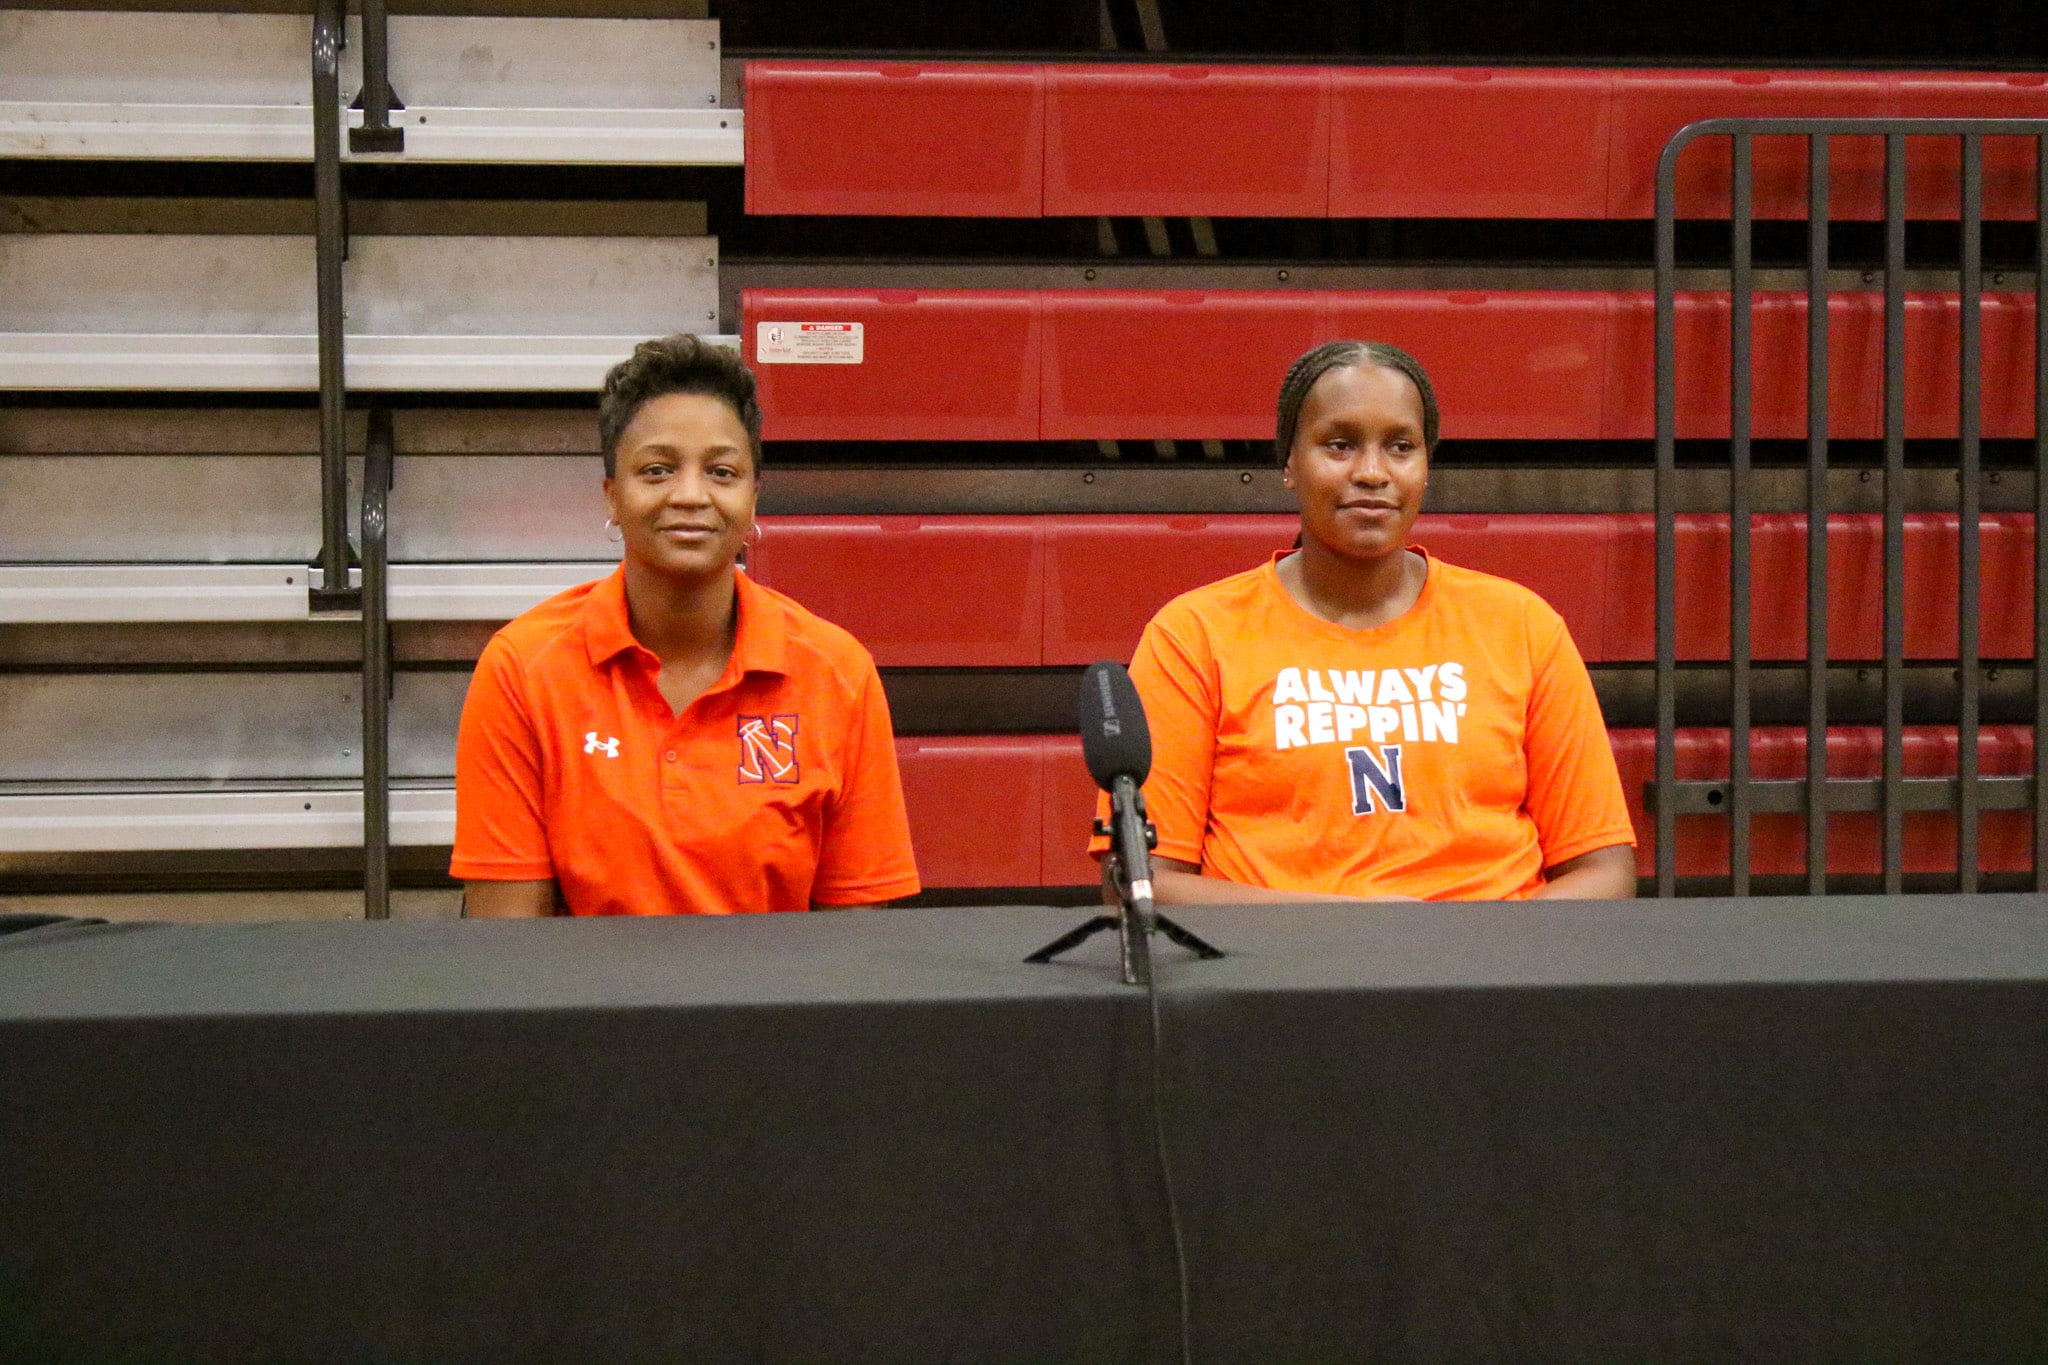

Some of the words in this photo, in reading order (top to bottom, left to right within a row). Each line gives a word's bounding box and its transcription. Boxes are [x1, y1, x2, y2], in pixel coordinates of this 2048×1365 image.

[1273, 661, 1467, 704] ALWAYS
[737, 713, 799, 786] N
[1274, 700, 1467, 750] REPPIN'
[1344, 744, 1407, 816] N
